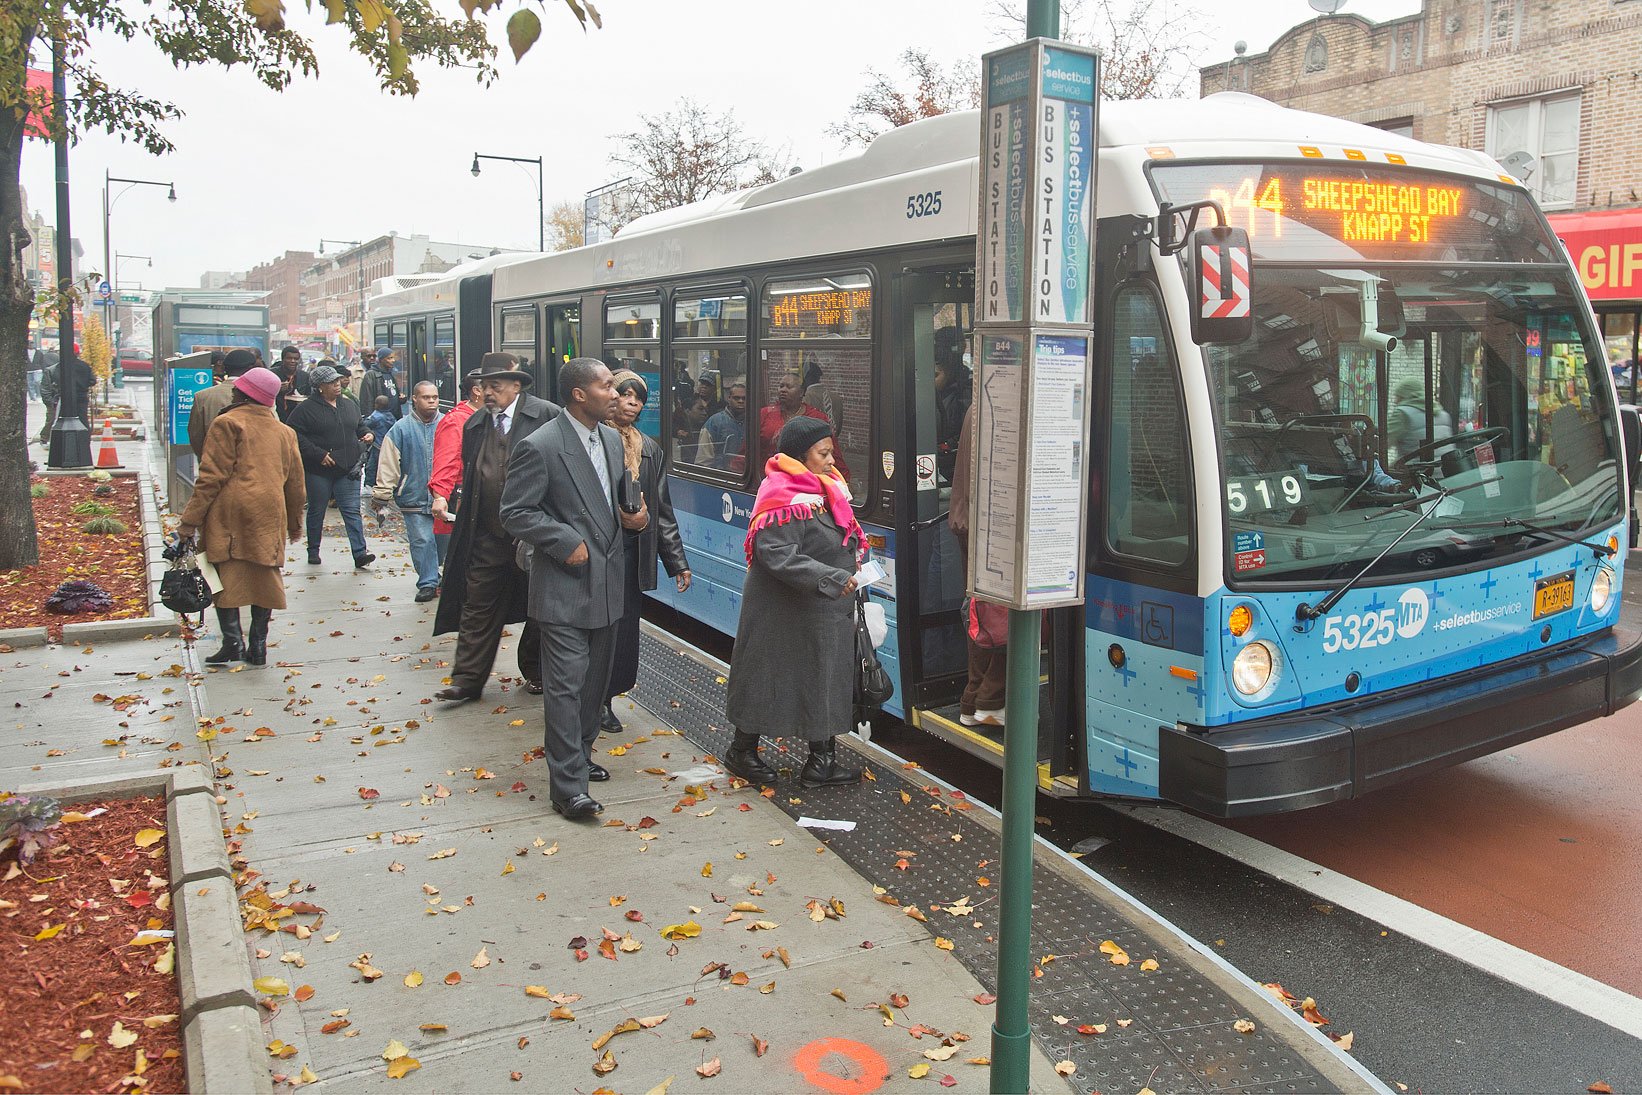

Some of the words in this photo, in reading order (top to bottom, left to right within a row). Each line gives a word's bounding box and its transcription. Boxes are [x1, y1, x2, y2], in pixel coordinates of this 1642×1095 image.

[1052, 82, 1081, 95] service
[993, 112, 1003, 169] BUS
[1044, 106, 1055, 163] BUS
[906, 190, 942, 219] 5325
[1303, 179, 1422, 214] SHEEPSHEAD
[1427, 188, 1461, 216] BAY
[1342, 212, 1403, 241] KNAPP
[1410, 215, 1430, 242] ST
[989, 181, 1000, 317] STATION
[1040, 177, 1054, 317] STATION
[774, 295, 799, 326] B44
[800, 291, 850, 311] SHEEPSHEAD
[852, 290, 871, 308] BAY
[816, 310, 841, 325] KNAPP
[843, 309, 853, 324] ST
[1039, 344, 1052, 354] Trip
[1052, 345, 1065, 355] tips
[1322, 608, 1396, 653] 5325
